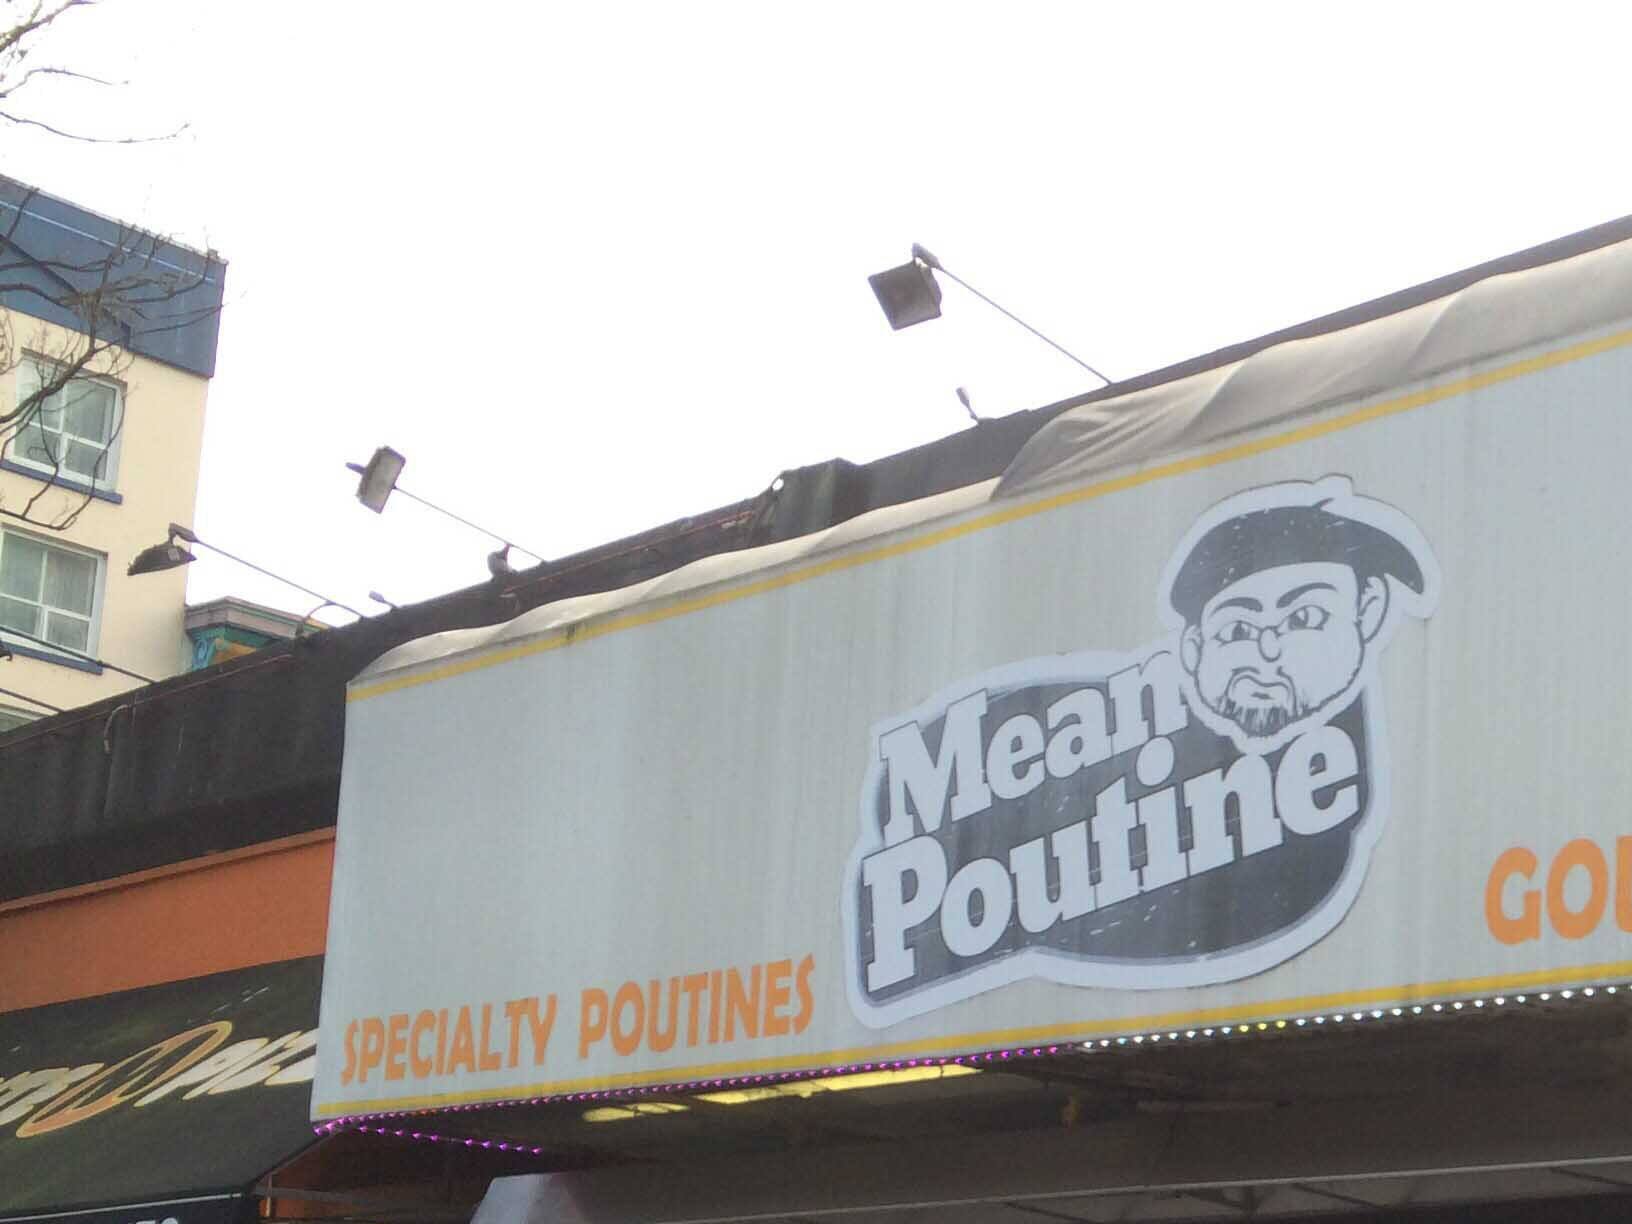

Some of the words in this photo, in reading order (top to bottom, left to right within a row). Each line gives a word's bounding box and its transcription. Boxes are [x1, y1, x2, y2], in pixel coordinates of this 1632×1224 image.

[878, 650, 1188, 846] Mean
[862, 724, 1361, 993] Poutine
[341, 993, 557, 1086] SPECIALTY
[578, 953, 815, 1060] POUTINES
